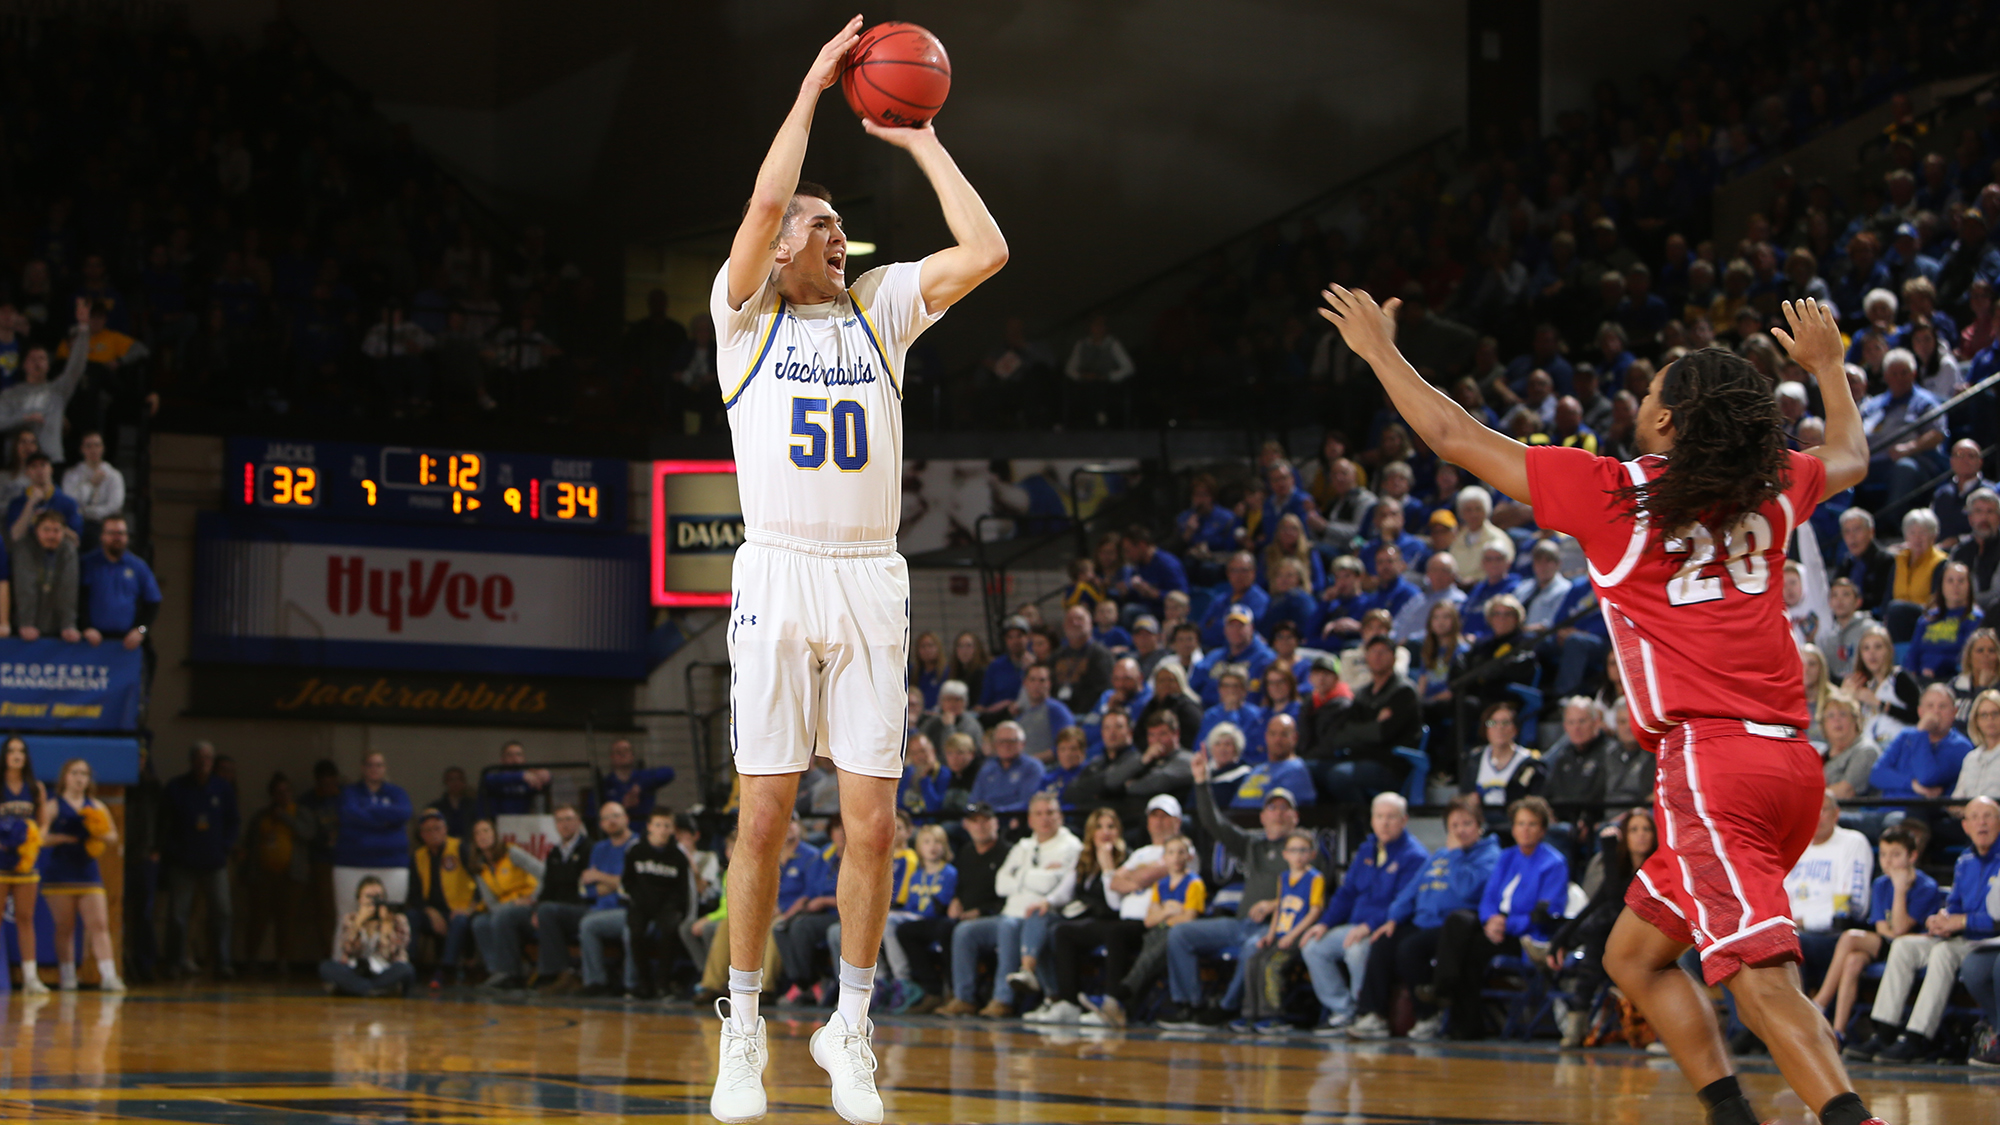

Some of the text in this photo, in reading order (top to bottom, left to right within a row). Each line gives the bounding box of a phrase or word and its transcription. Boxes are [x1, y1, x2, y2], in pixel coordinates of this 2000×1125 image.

[788, 396, 870, 472] 50
[272, 466, 316, 505] 32
[419, 454, 481, 491] 1:12
[361, 479, 377, 506] 7
[503, 487, 522, 514] 9
[557, 482, 598, 519] 34
[1664, 512, 1772, 607] 20
[0, 663, 109, 677] PROPERTY
[0, 677, 109, 691] MANAGEMENT
[275, 677, 548, 713] Jackrabbits
